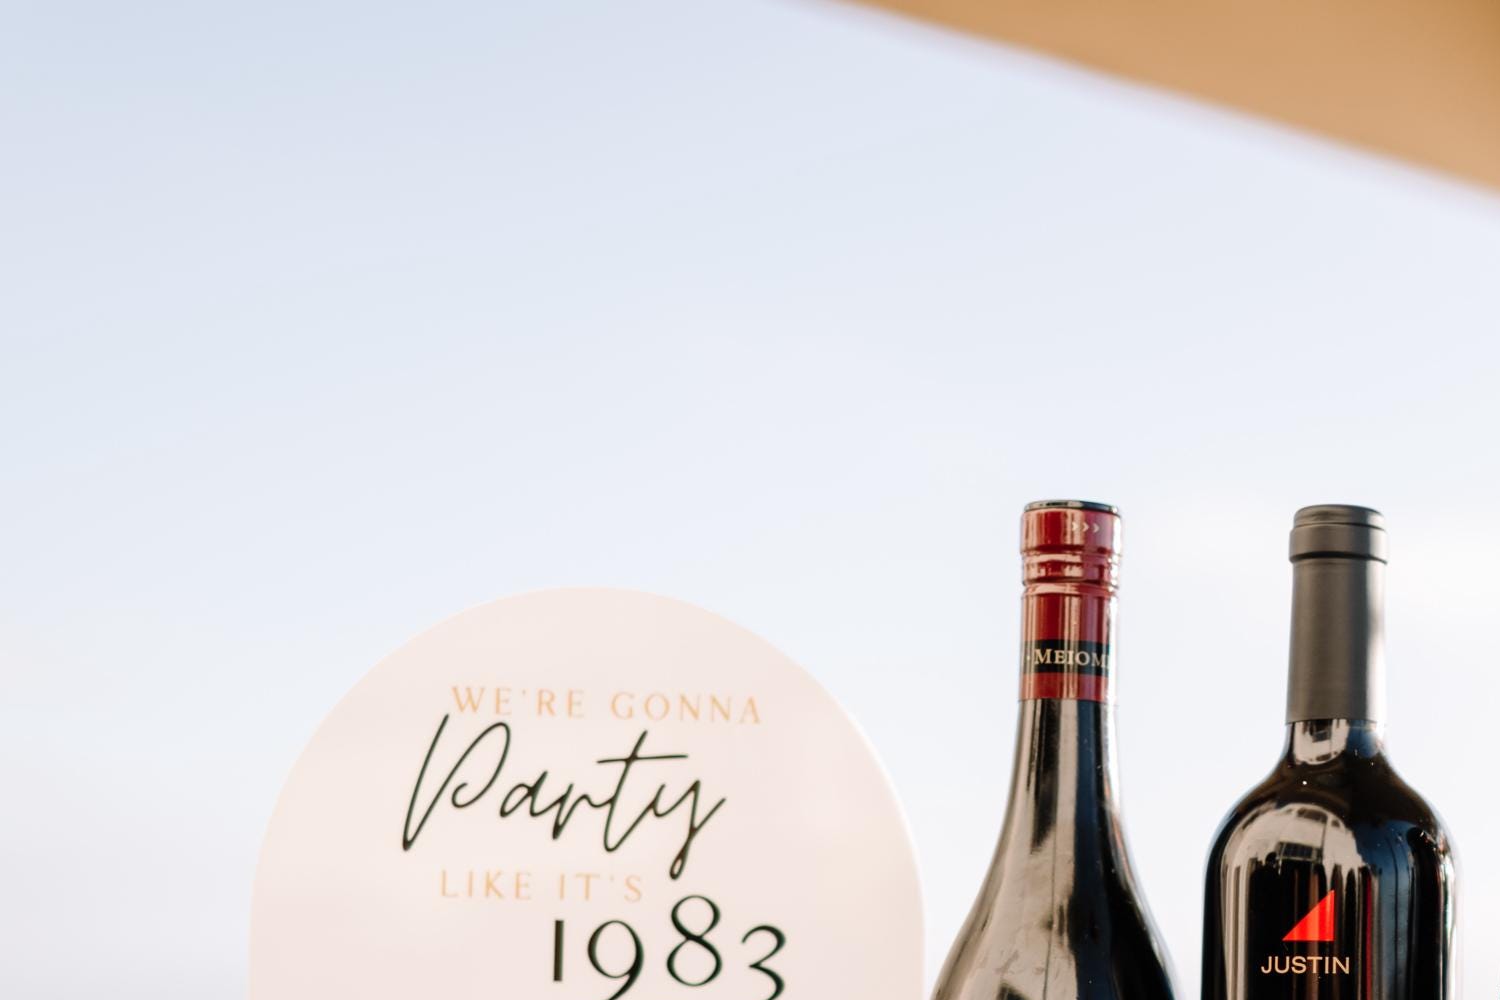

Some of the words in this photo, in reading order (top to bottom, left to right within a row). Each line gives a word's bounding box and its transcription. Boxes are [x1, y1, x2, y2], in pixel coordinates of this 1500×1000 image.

[1034, 648, 1108, 668] MEIOM
[452, 685, 586, 718] WE'RE
[610, 691, 762, 724] GONNA
[402, 713, 726, 879] Party
[440, 868, 532, 900] LIKE
[559, 872, 643, 902] IT'S
[1260, 955, 1349, 975] JUSTIN
